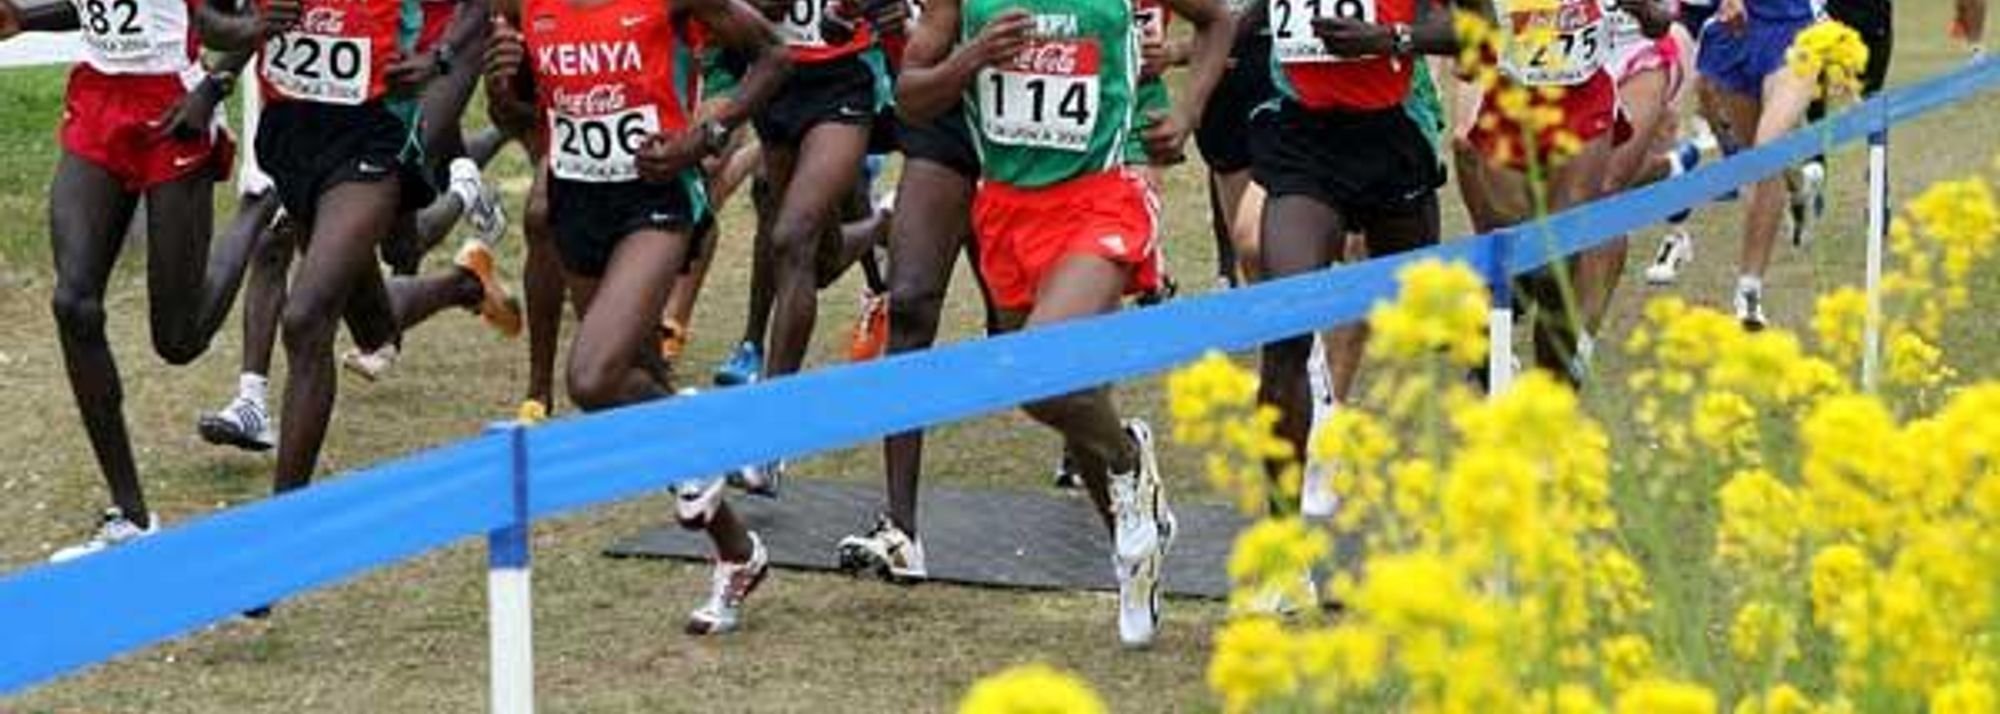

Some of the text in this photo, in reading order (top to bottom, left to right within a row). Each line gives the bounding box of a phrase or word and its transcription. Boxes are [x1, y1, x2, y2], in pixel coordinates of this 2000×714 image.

[82, 0, 144, 35] 82
[267, 31, 362, 79] 220
[538, 41, 642, 76] KENYA
[990, 74, 1090, 126] 114
[556, 112, 647, 160] 206
